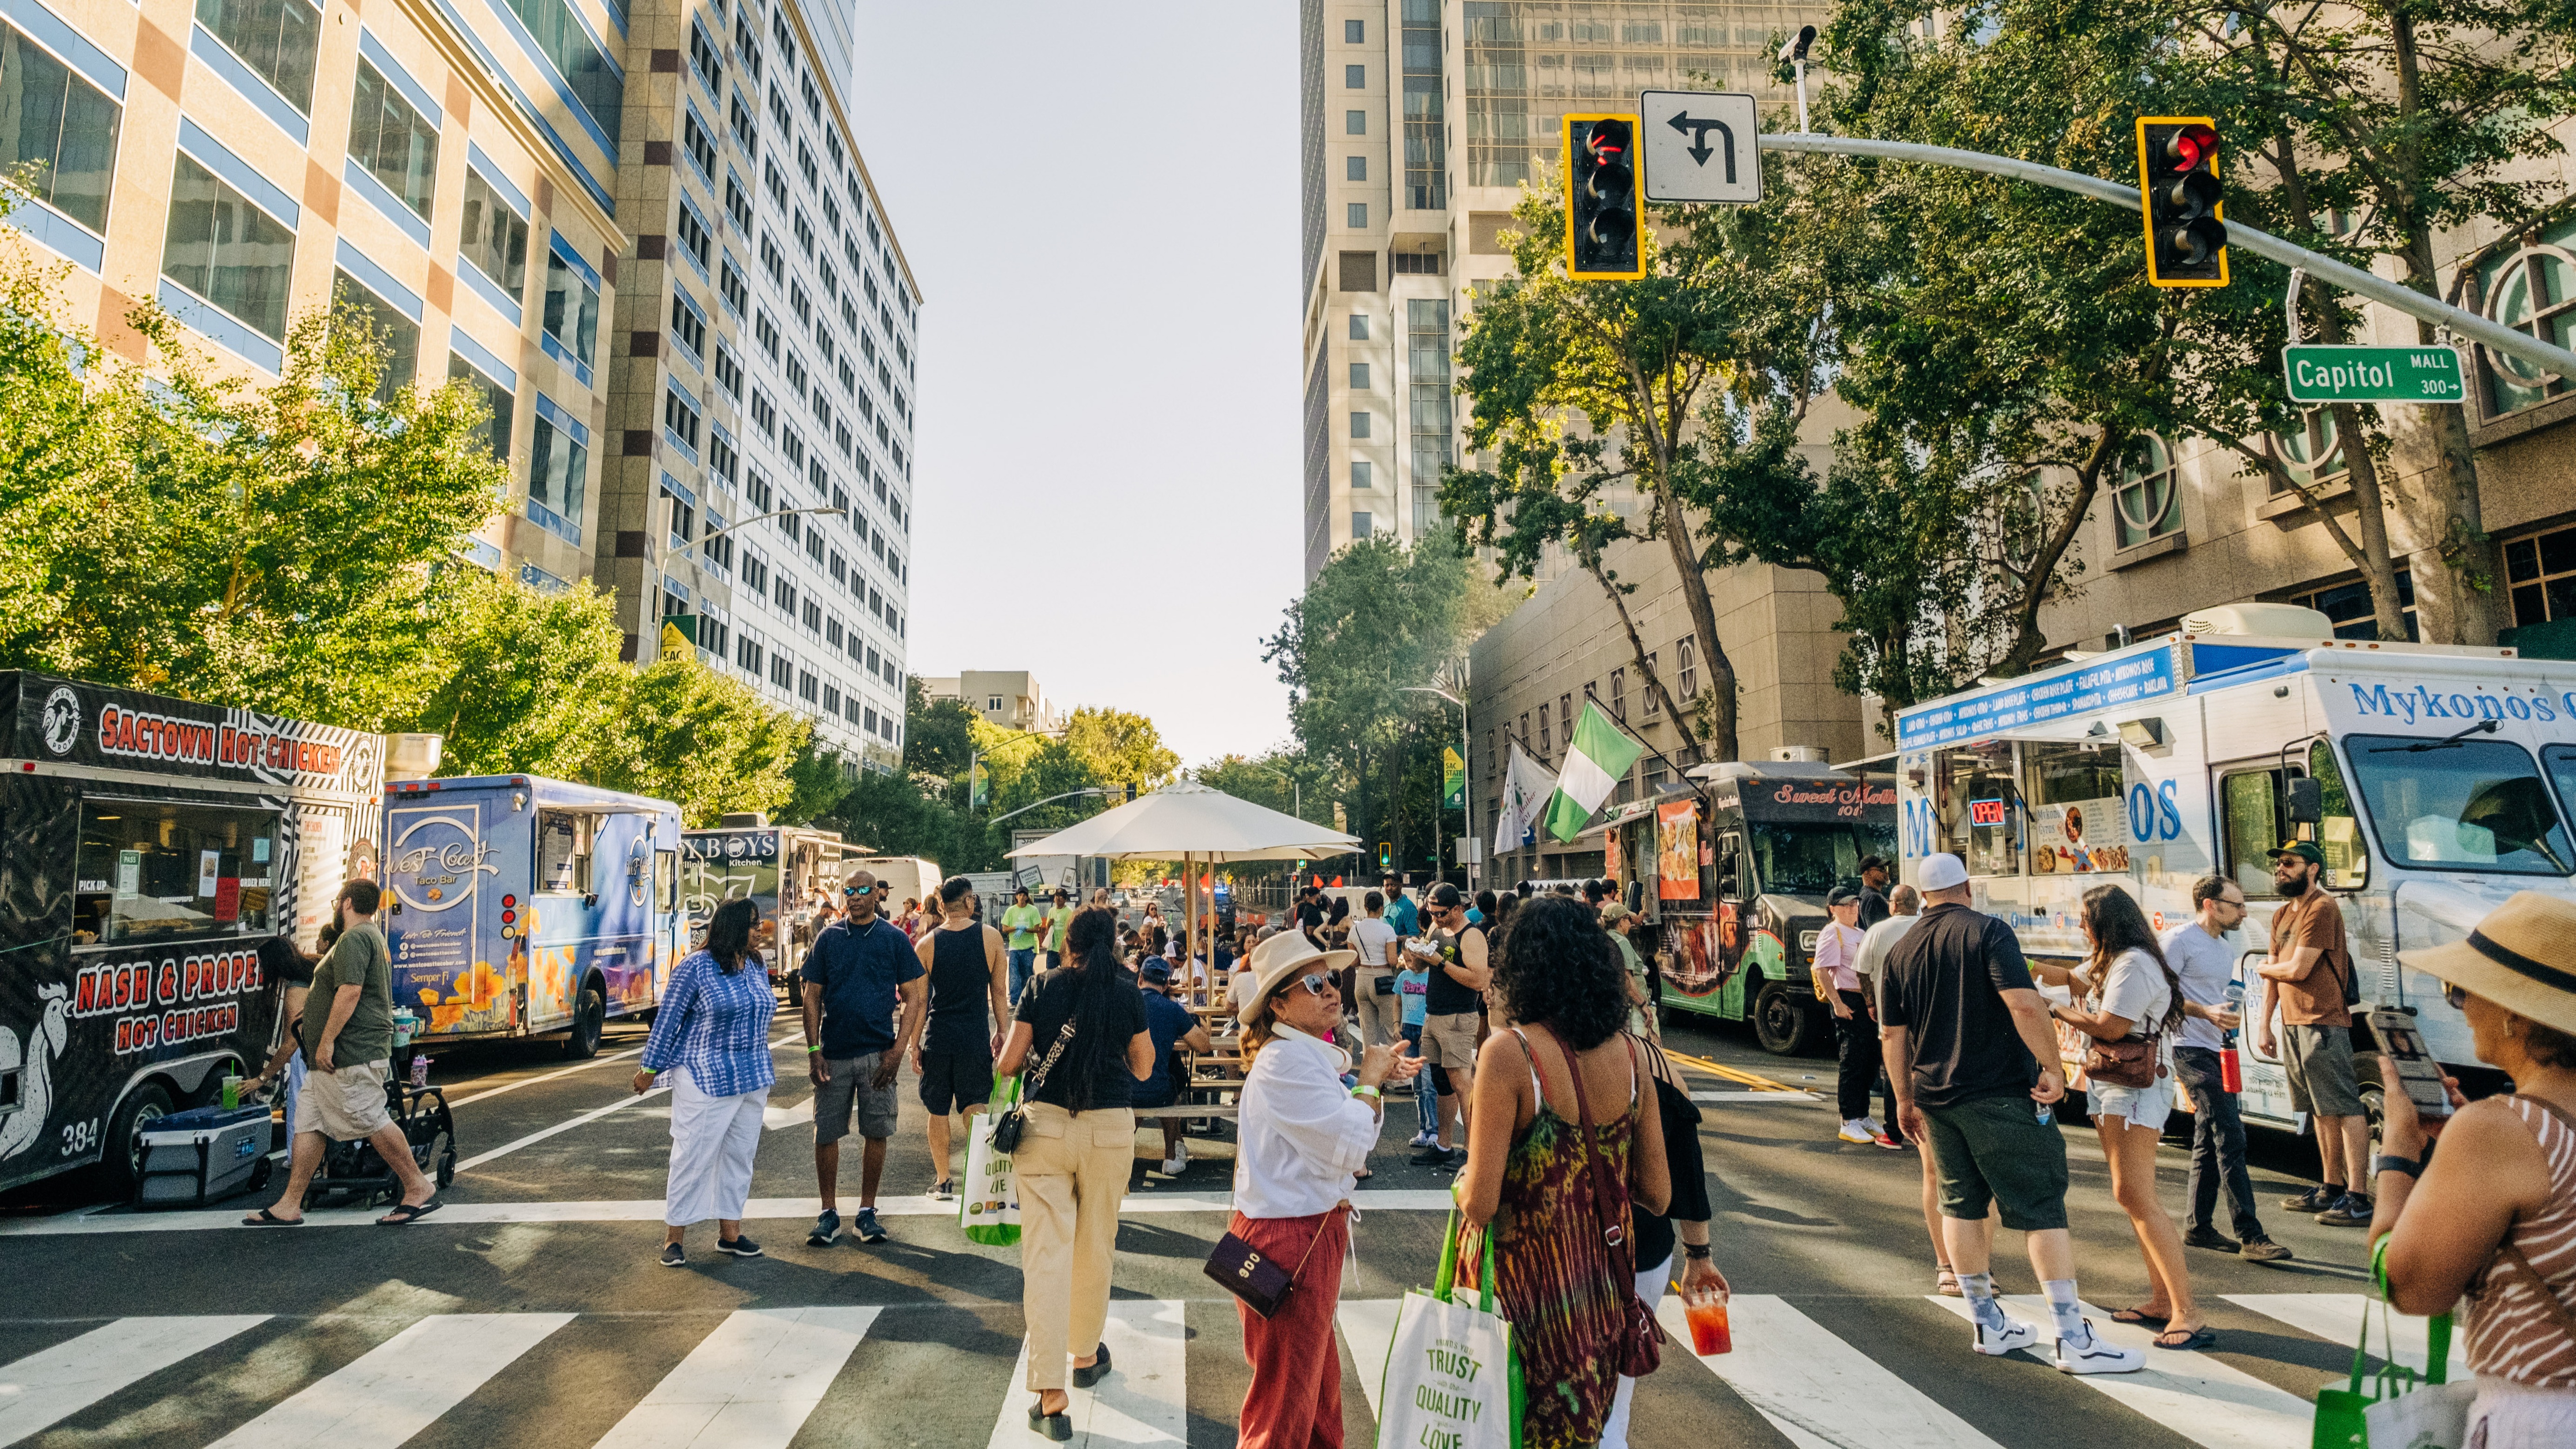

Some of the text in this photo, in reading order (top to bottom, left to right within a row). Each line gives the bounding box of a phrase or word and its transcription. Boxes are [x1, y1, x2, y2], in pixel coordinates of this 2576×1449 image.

[2410, 354, 2449, 369] MALL
[2297, 360, 2393, 394] Capitol
[2421, 380, 2447, 395] 300
[664, 650, 682, 661] SAC
[2031, 686, 2049, 702] CHICKEN
[2049, 683, 2059, 698] RICE
[2059, 679, 2073, 695] PLATE
[2079, 672, 2100, 690] FALAFEL
[2100, 670, 2112, 685] PITA
[2115, 661, 2140, 682] MYKONOS
[2141, 657, 2154, 674] RICE
[49, 689, 70, 704] NASH
[2033, 704, 2050, 719] CHICKEN
[2107, 683, 2138, 703] CHEESECAKE
[2144, 676, 2168, 694] BAKLAVA
[2348, 683, 2556, 725] Mykonos
[100, 705, 215, 763] SACTOWN
[219, 725, 262, 768] HOT
[265, 732, 342, 776] CHICKEN
[1774, 785, 1837, 804] Sweet
[1838, 805, 1861, 816] 101
[1972, 801, 2004, 824] OPEN
[380, 840, 500, 876] West Coast
[79, 880, 107, 892] PICK UP
[240, 878, 271, 887] ORDER HERE
[415, 875, 456, 885] Taco Bar
[2328, 873, 2336, 885] 26
[434, 928, 467, 938] Friends
[410, 941, 462, 950] @westcoasttacobar
[393, 959, 467, 969] www.westcoasttacobar.com
[411, 971, 449, 986] Semper Fi
[75, 962, 151, 1017] NASH
[158, 959, 177, 1005] &
[115, 1002, 238, 1054] HOT CHICKEN
[61, 1118, 98, 1156] 384
[1436, 1338, 1474, 1355] BRANDS YOU
[1426, 1349, 1482, 1383] TRUST
[1415, 1384, 1482, 1423] QUALITY
[1420, 1423, 1463, 1449] LOVE
